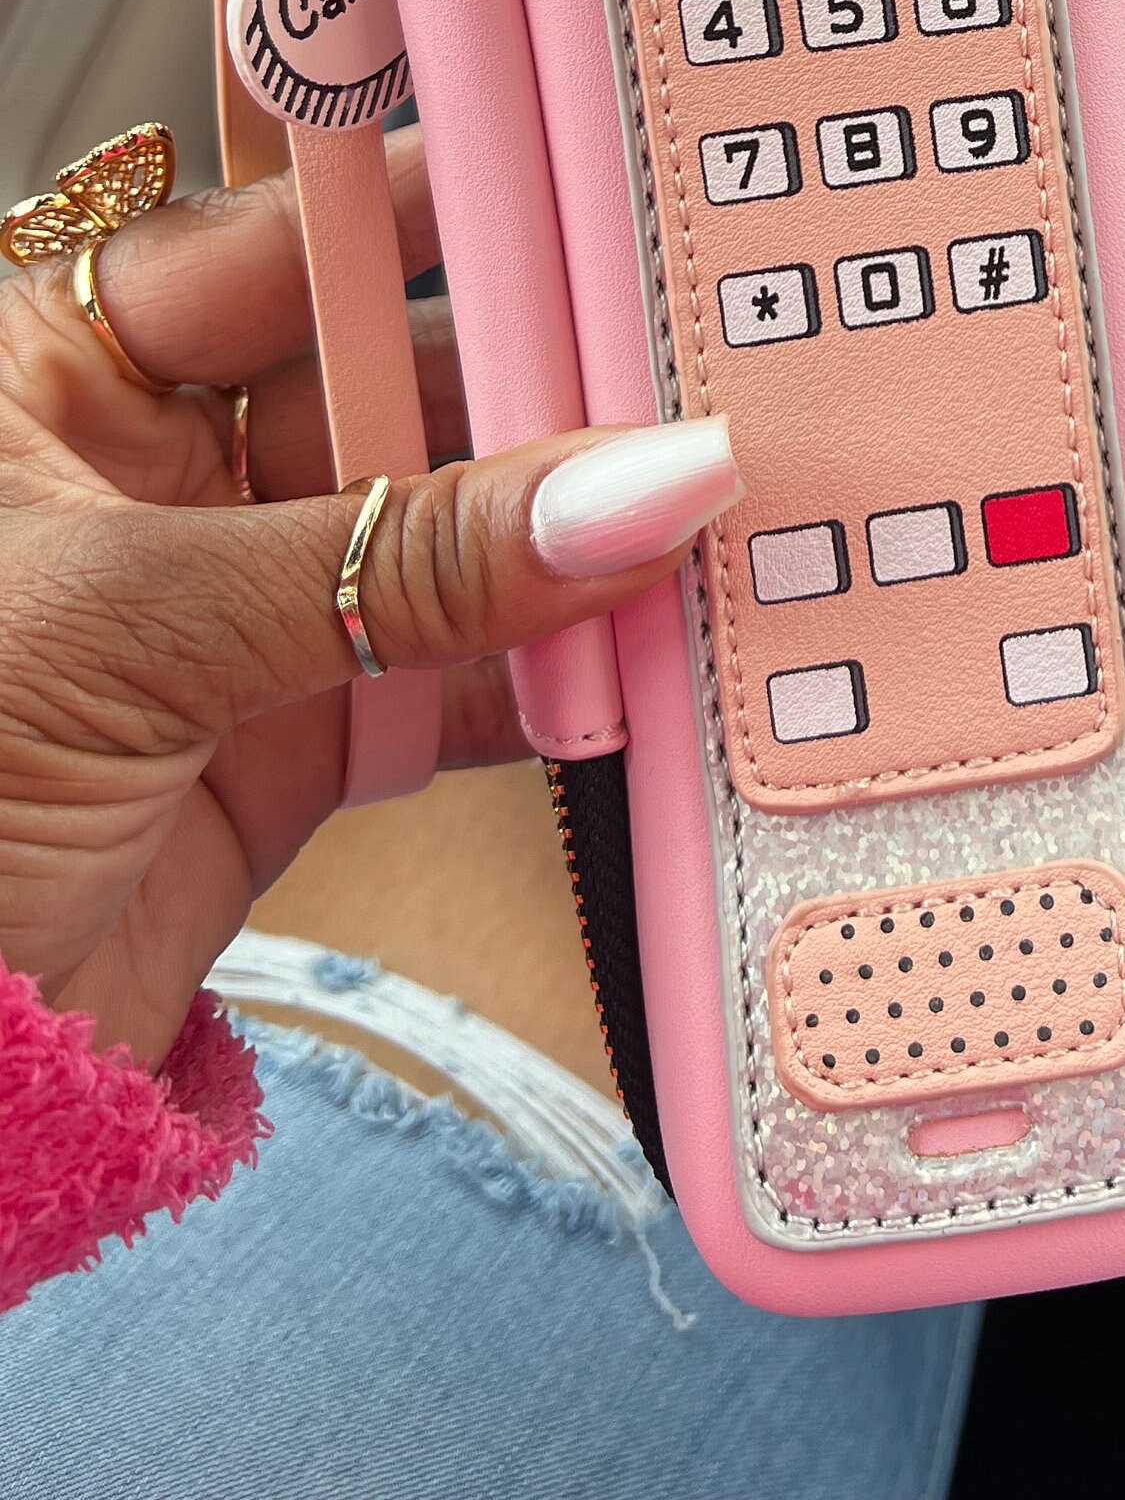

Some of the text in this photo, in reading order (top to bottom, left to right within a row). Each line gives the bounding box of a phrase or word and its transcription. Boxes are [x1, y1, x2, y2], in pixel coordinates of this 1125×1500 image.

[702, 0, 743, 50] 4
[723, 107, 997, 190] 7 8 9
[860, 261, 901, 313] 0
[978, 245, 1010, 301] #
